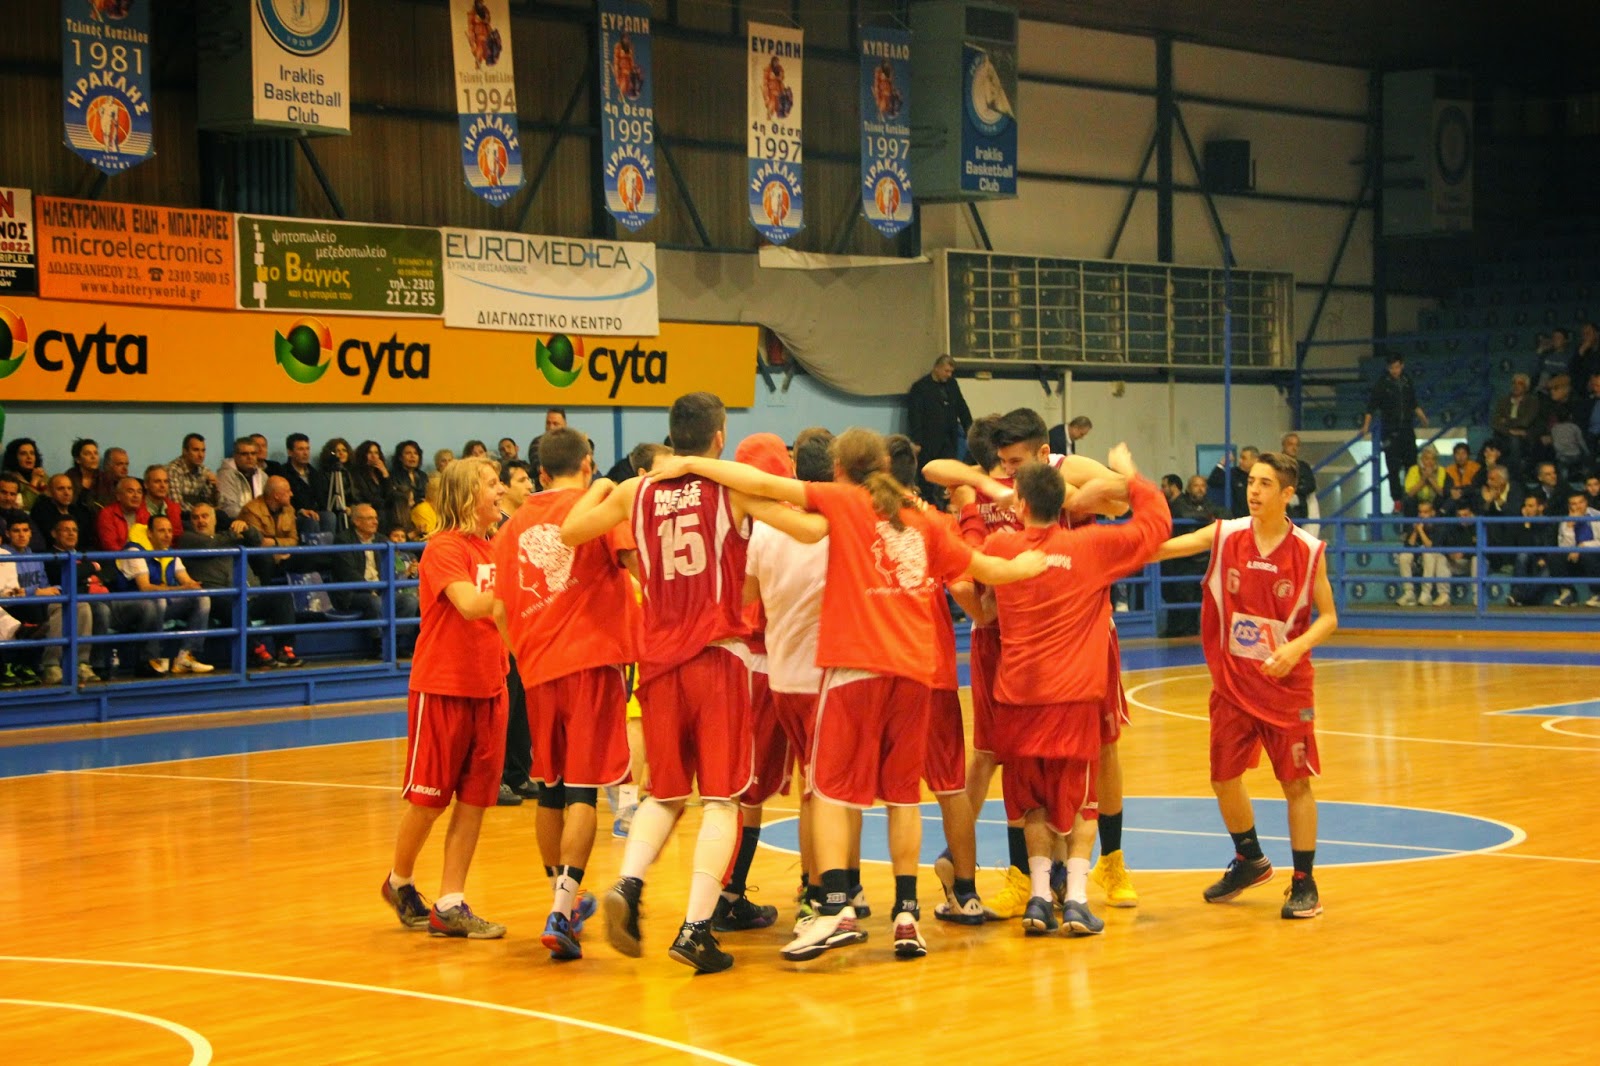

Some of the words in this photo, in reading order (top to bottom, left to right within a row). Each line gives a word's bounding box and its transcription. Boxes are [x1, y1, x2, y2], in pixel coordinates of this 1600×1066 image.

[601, 12, 650, 34] ΕΥΡΩΠΗ
[72, 38, 142, 75] 1981
[752, 35, 801, 59] ΕΥΡΩΠΗ
[863, 40, 910, 60] ΚΥΠΕΛΛΟ
[280, 64, 325, 86] Iraklis
[67, 70, 149, 116] ΗΡΑΚΛΗΣ
[264, 82, 342, 108] Basketball
[463, 87, 515, 113] 1994
[287, 105, 320, 124] Club
[463, 113, 519, 151] ΗΡΑΚΛΗΣ
[608, 118, 654, 144] 1995
[752, 120, 766, 136] 4η
[755, 136, 802, 162] 1997
[867, 136, 910, 160] 1997
[975, 146, 1003, 161] Iraklis
[606, 143, 655, 180] ΗΡΑΚΛΗΣ
[865, 158, 911, 191] ΗΡΑΚΛΗΣ
[966, 160, 1013, 178] Basketball
[751, 160, 802, 197] ΗΡΑΚΛΗΣ
[980, 177, 1000, 192] Club
[43, 199, 127, 232] ΗΛΕΚΤΡΟΝΙΚΑ
[132, 207, 159, 235] ΕΙΔΗ
[168, 211, 229, 240] ΜΠΑΤΑΡΙΕΣ
[52, 232, 223, 265] microelectronics
[272, 229, 337, 246] ψητοπωλείο
[315, 244, 387, 261] μεζεδοπωλείο
[446, 233, 632, 270] EUROMEDICA
[48, 261, 123, 279] ΔΩΔΕΚΑΝΗΣΟΥ
[168, 268, 192, 283] 2310
[194, 270, 217, 285] 5000
[220, 273, 230, 286] 15
[285, 251, 351, 289] Βάγγος
[81, 281, 202, 302] www.batteryworld.gr
[412, 278, 435, 290] 2310
[386, 290, 401, 305] 21
[404, 291, 419, 306] 22
[421, 291, 436, 306] 55
[477, 310, 567, 328] ΔΙΑΓΝΩΣΤΙΚΟ
[571, 315, 623, 331] ΚΕΝΤΡΟ
[34, 322, 148, 392] cyta
[337, 332, 430, 395] cyta
[588, 341, 667, 399] cyta
[657, 512, 707, 581] 15
[1227, 567, 1241, 595] 6
[410, 783, 441, 797] LEGEA
